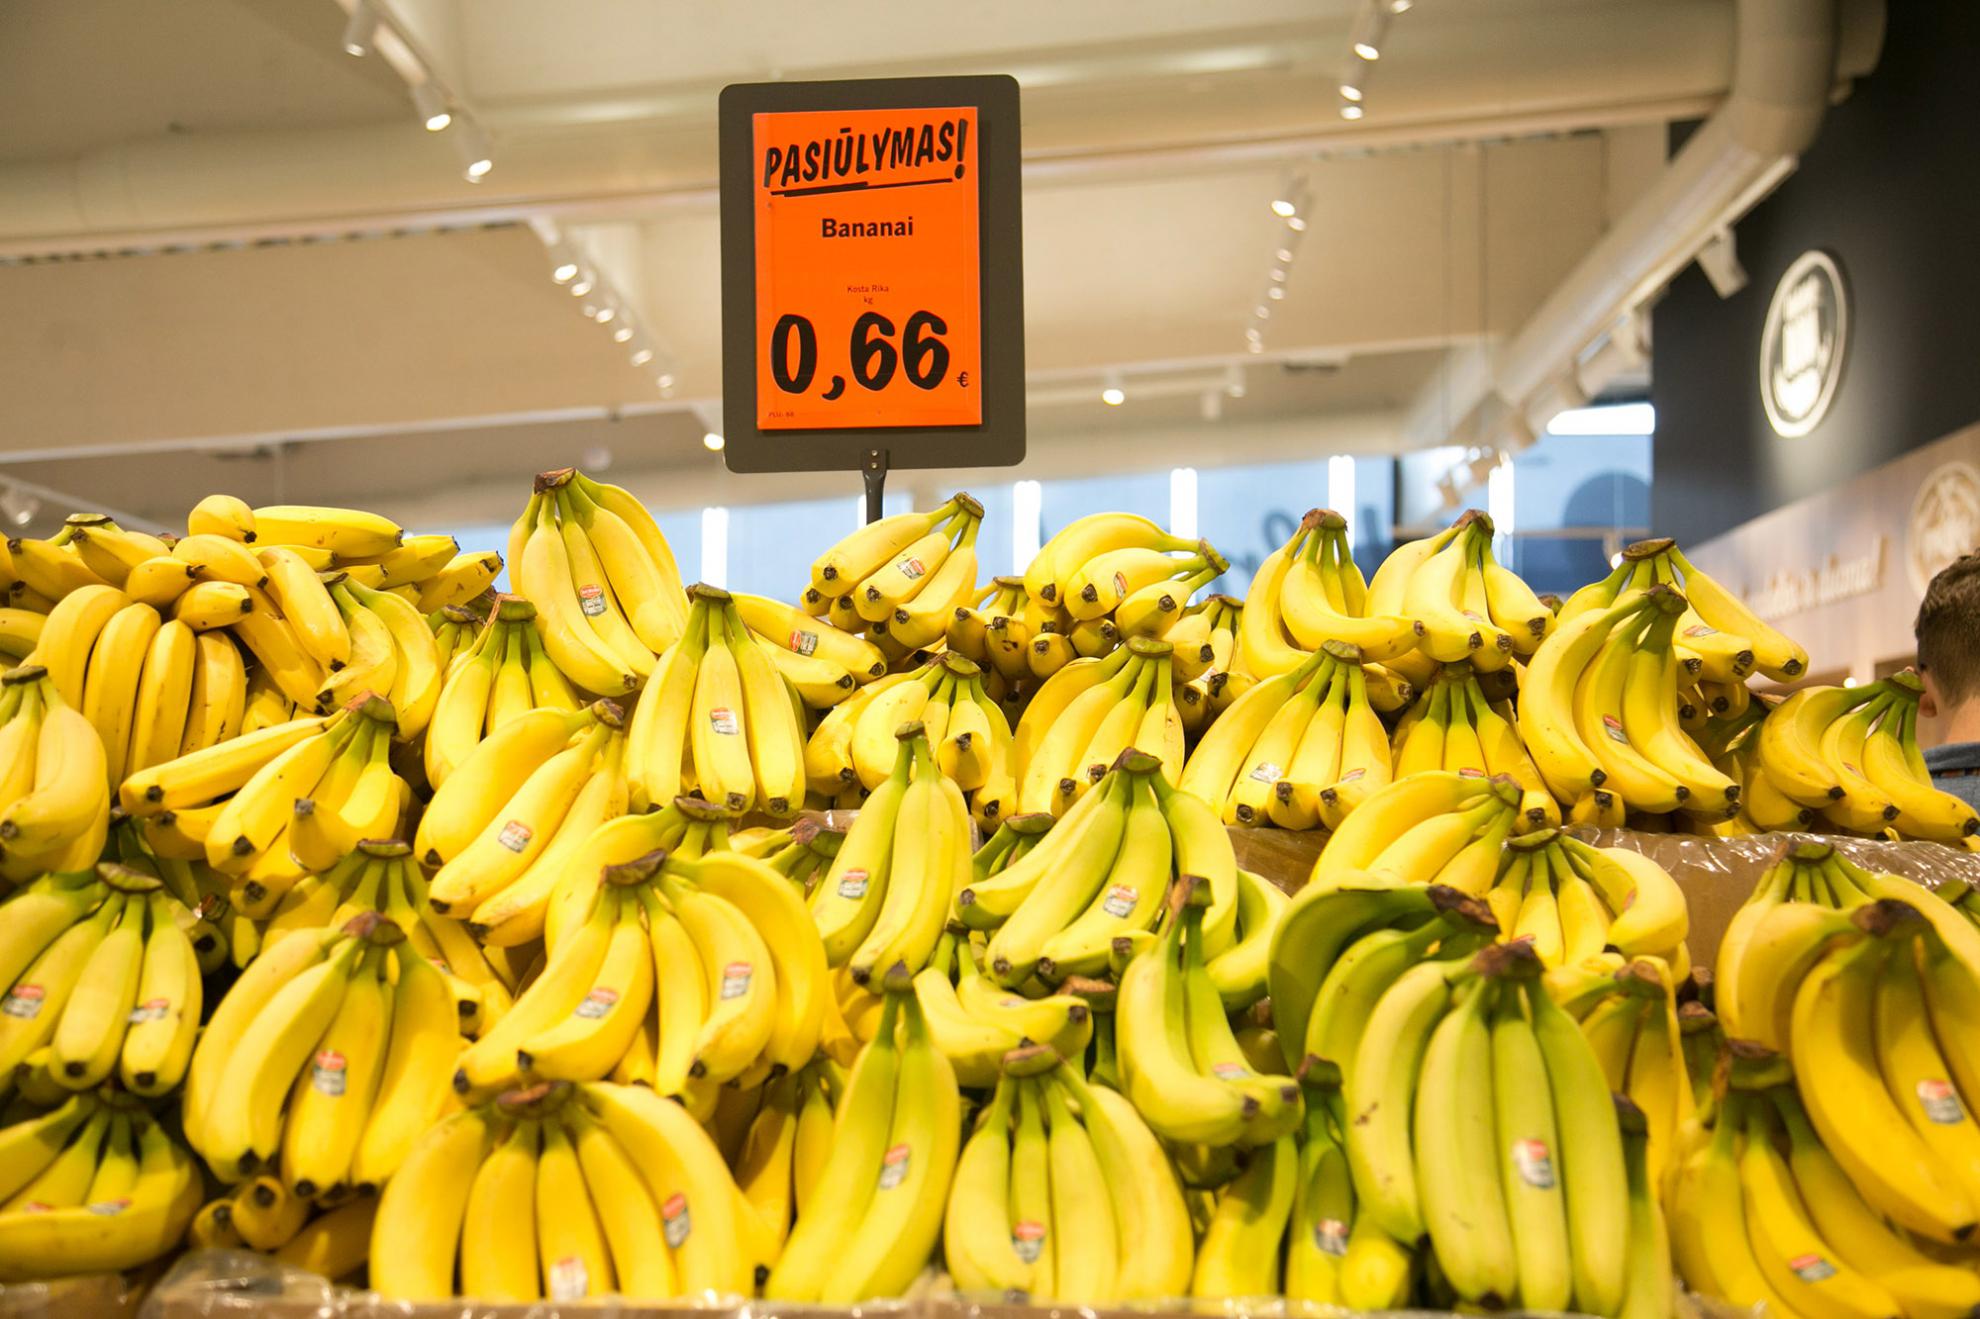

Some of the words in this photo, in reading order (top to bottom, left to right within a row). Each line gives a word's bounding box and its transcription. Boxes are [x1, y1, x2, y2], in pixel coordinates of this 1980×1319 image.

[763, 118, 969, 188] PASIŪLYMAS!
[821, 216, 914, 238] Bananai
[847, 285, 870, 293] Kosta
[872, 284, 889, 293] Rika
[771, 310, 950, 401] 0,66
[957, 372, 969, 388] €
